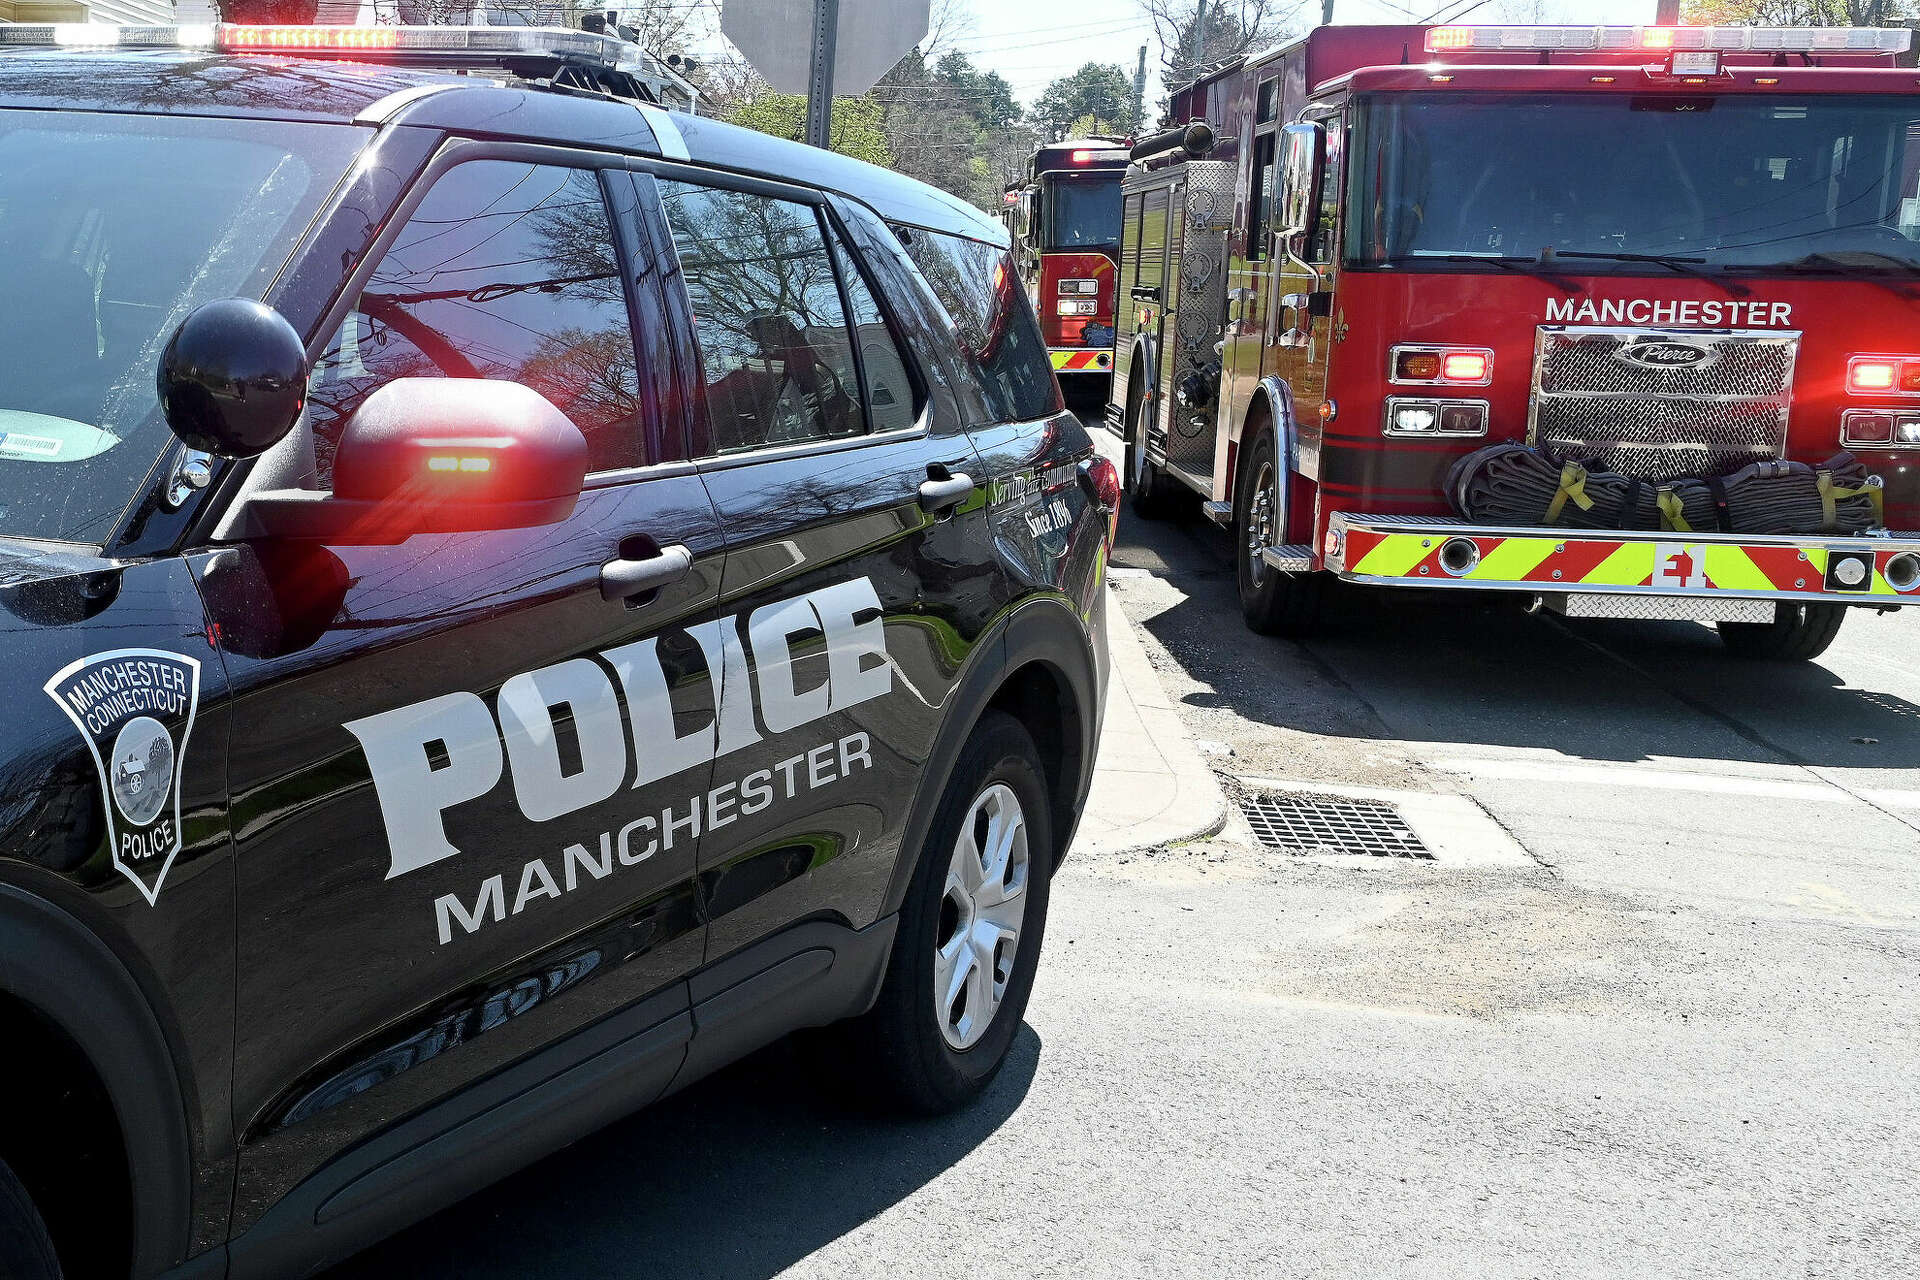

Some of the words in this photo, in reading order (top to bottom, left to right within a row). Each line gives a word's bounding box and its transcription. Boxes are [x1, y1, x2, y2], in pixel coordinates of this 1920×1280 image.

[1545, 297, 1793, 327] MANCHESTER
[1641, 346, 1697, 363] Pierce
[991, 474, 1026, 507] Serving
[1025, 511, 1053, 538] Since
[1048, 499, 1073, 529] 1896
[1651, 542, 1707, 588] E1
[67, 661, 187, 715] MANCHESTER
[86, 688, 187, 736] CONNECTICUT
[342, 576, 892, 881] POLICE
[121, 820, 174, 859] POLICE
[434, 731, 874, 945] MANCHESTER
